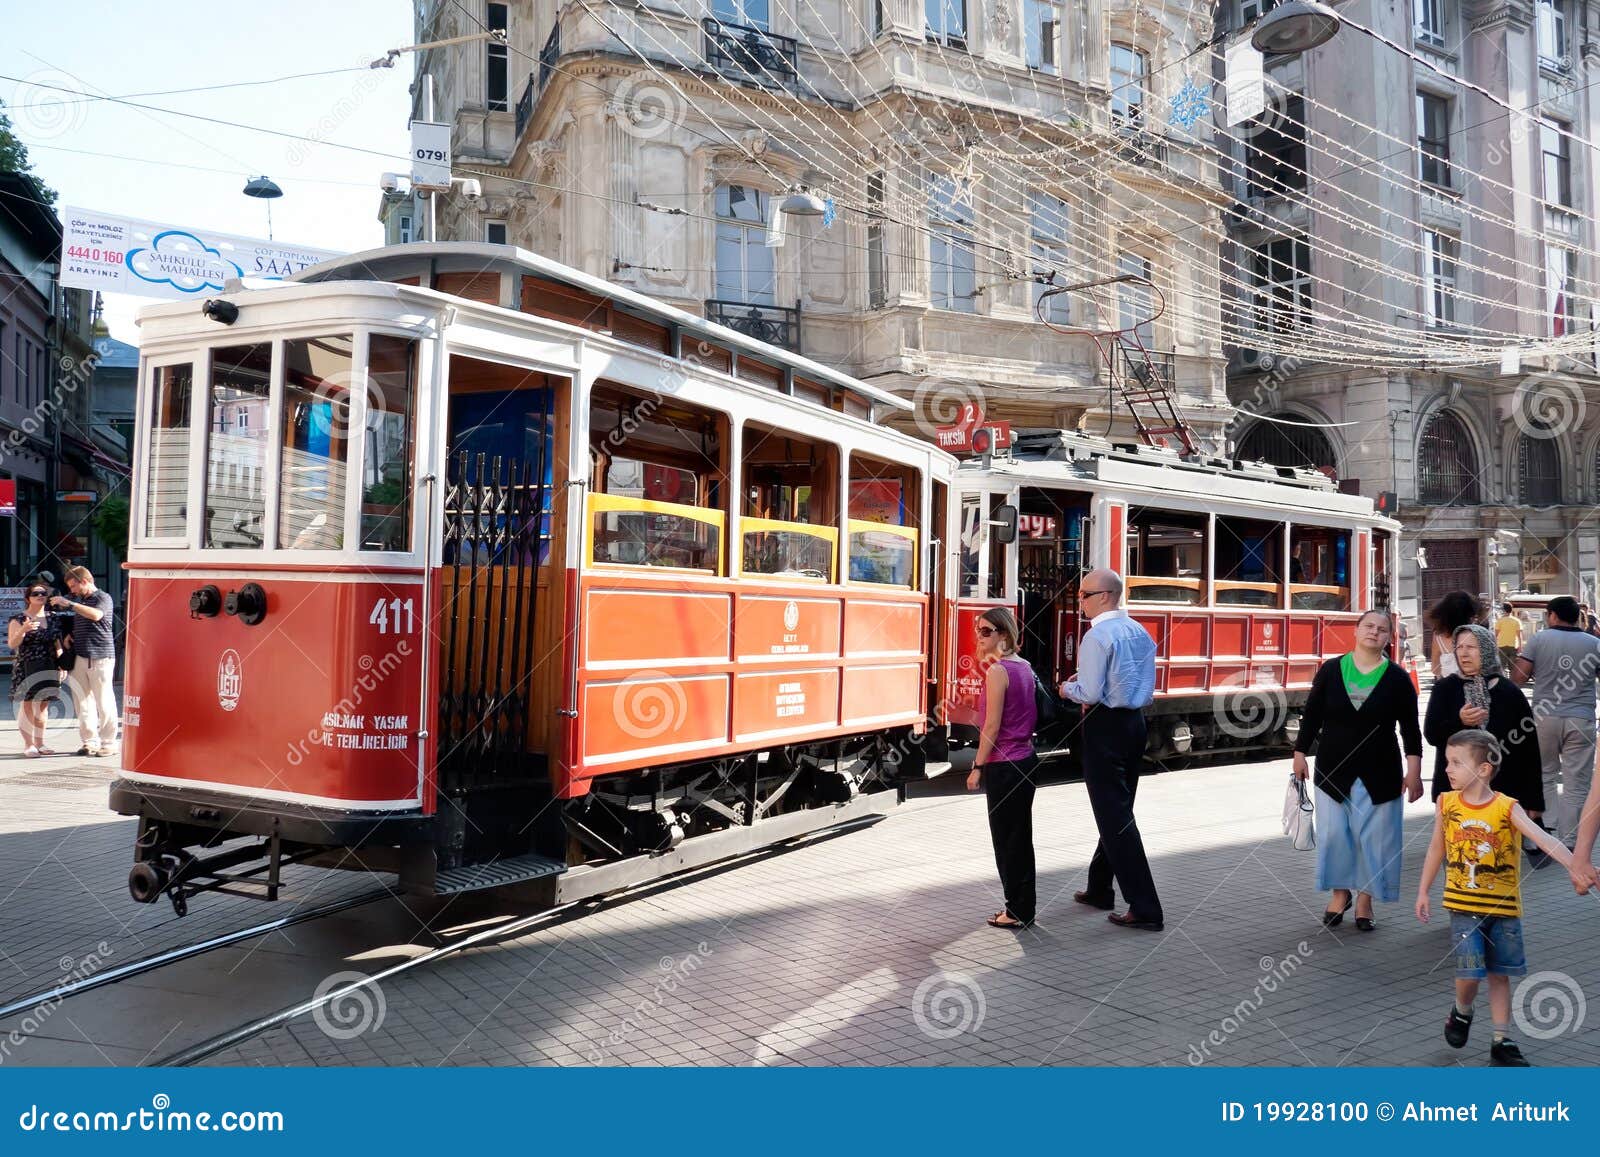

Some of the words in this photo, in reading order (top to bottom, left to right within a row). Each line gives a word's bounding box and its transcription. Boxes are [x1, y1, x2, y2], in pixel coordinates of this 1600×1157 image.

[67, 245, 90, 260] 444
[92, 248, 101, 260] 0
[103, 250, 124, 265] 160
[965, 405, 975, 423] 2
[369, 598, 414, 634] 411
[373, 715, 408, 730] YASAK
